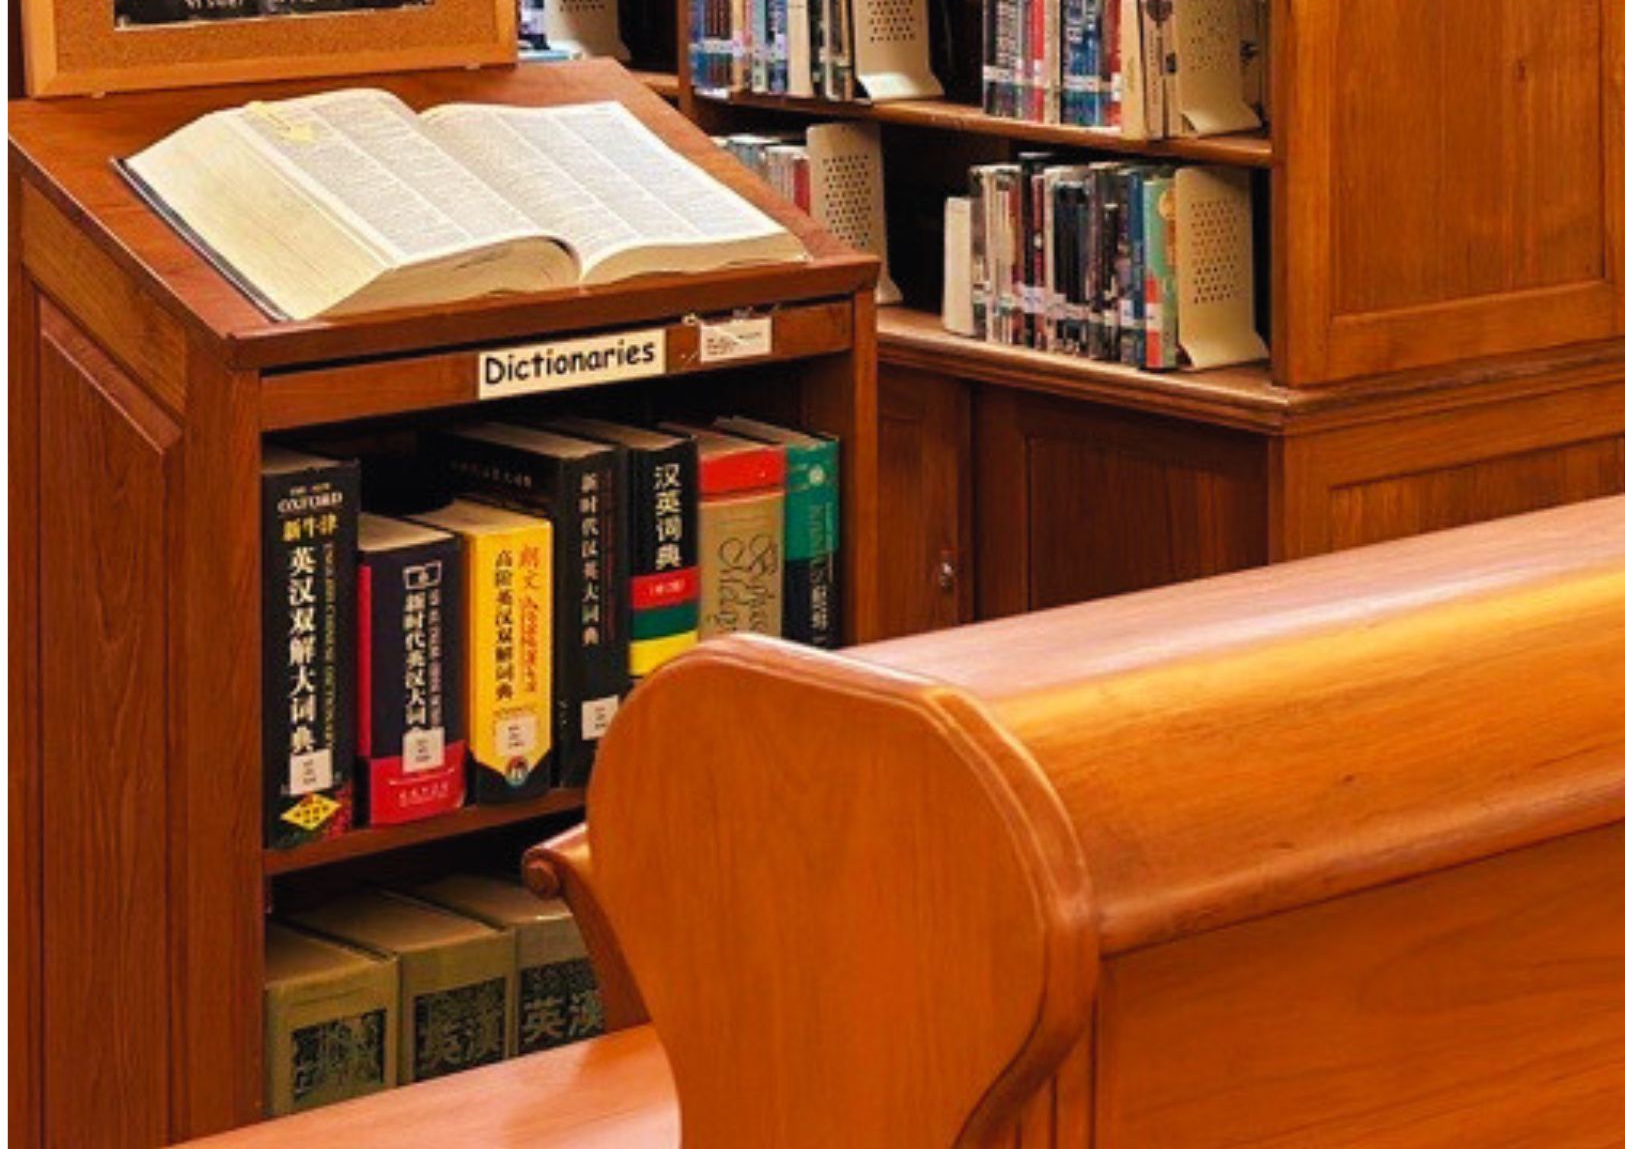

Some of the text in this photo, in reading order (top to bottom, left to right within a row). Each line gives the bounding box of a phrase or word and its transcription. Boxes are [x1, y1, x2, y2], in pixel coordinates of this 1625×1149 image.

[485, 338, 656, 386] Dictionaries
[653, 462, 683, 572] 汉英词典
